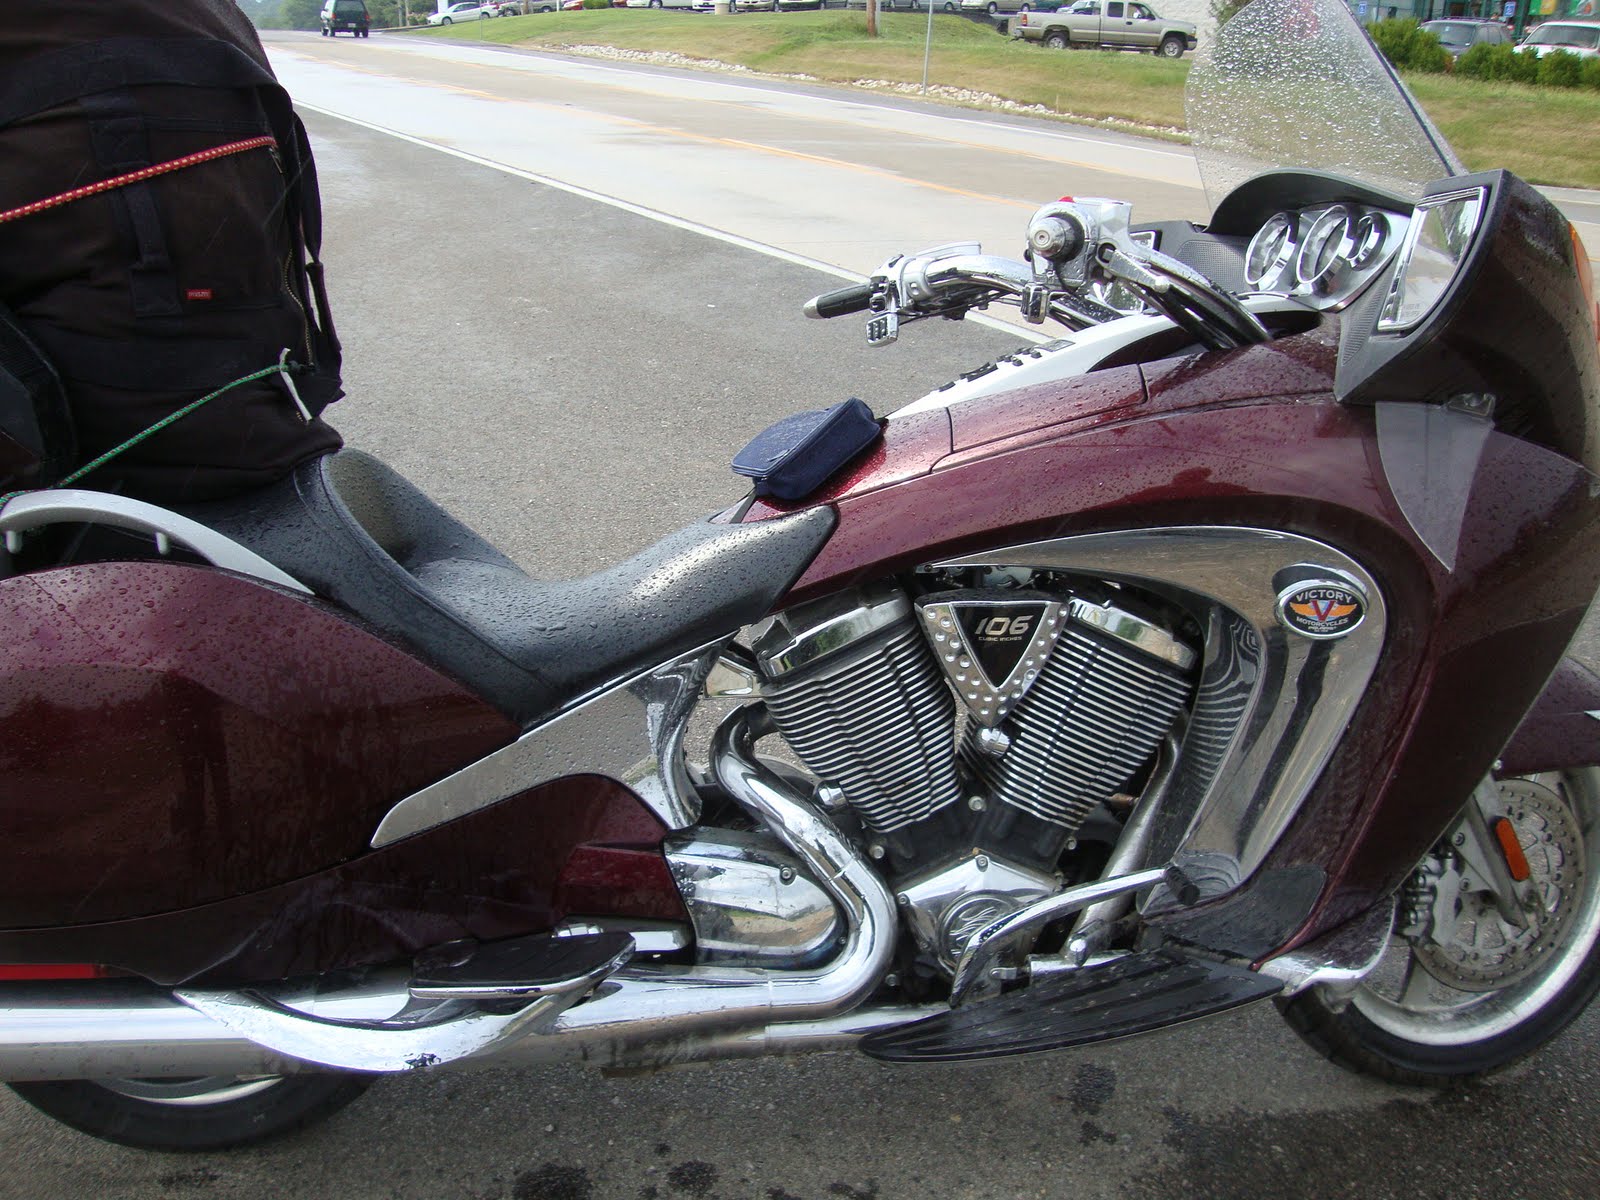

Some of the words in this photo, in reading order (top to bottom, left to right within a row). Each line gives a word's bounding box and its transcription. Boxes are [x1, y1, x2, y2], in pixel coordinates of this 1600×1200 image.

[1296, 589, 1353, 603] VICTORY
[975, 615, 1034, 636] 106
[1296, 616, 1349, 627] MOTORCYCLES
